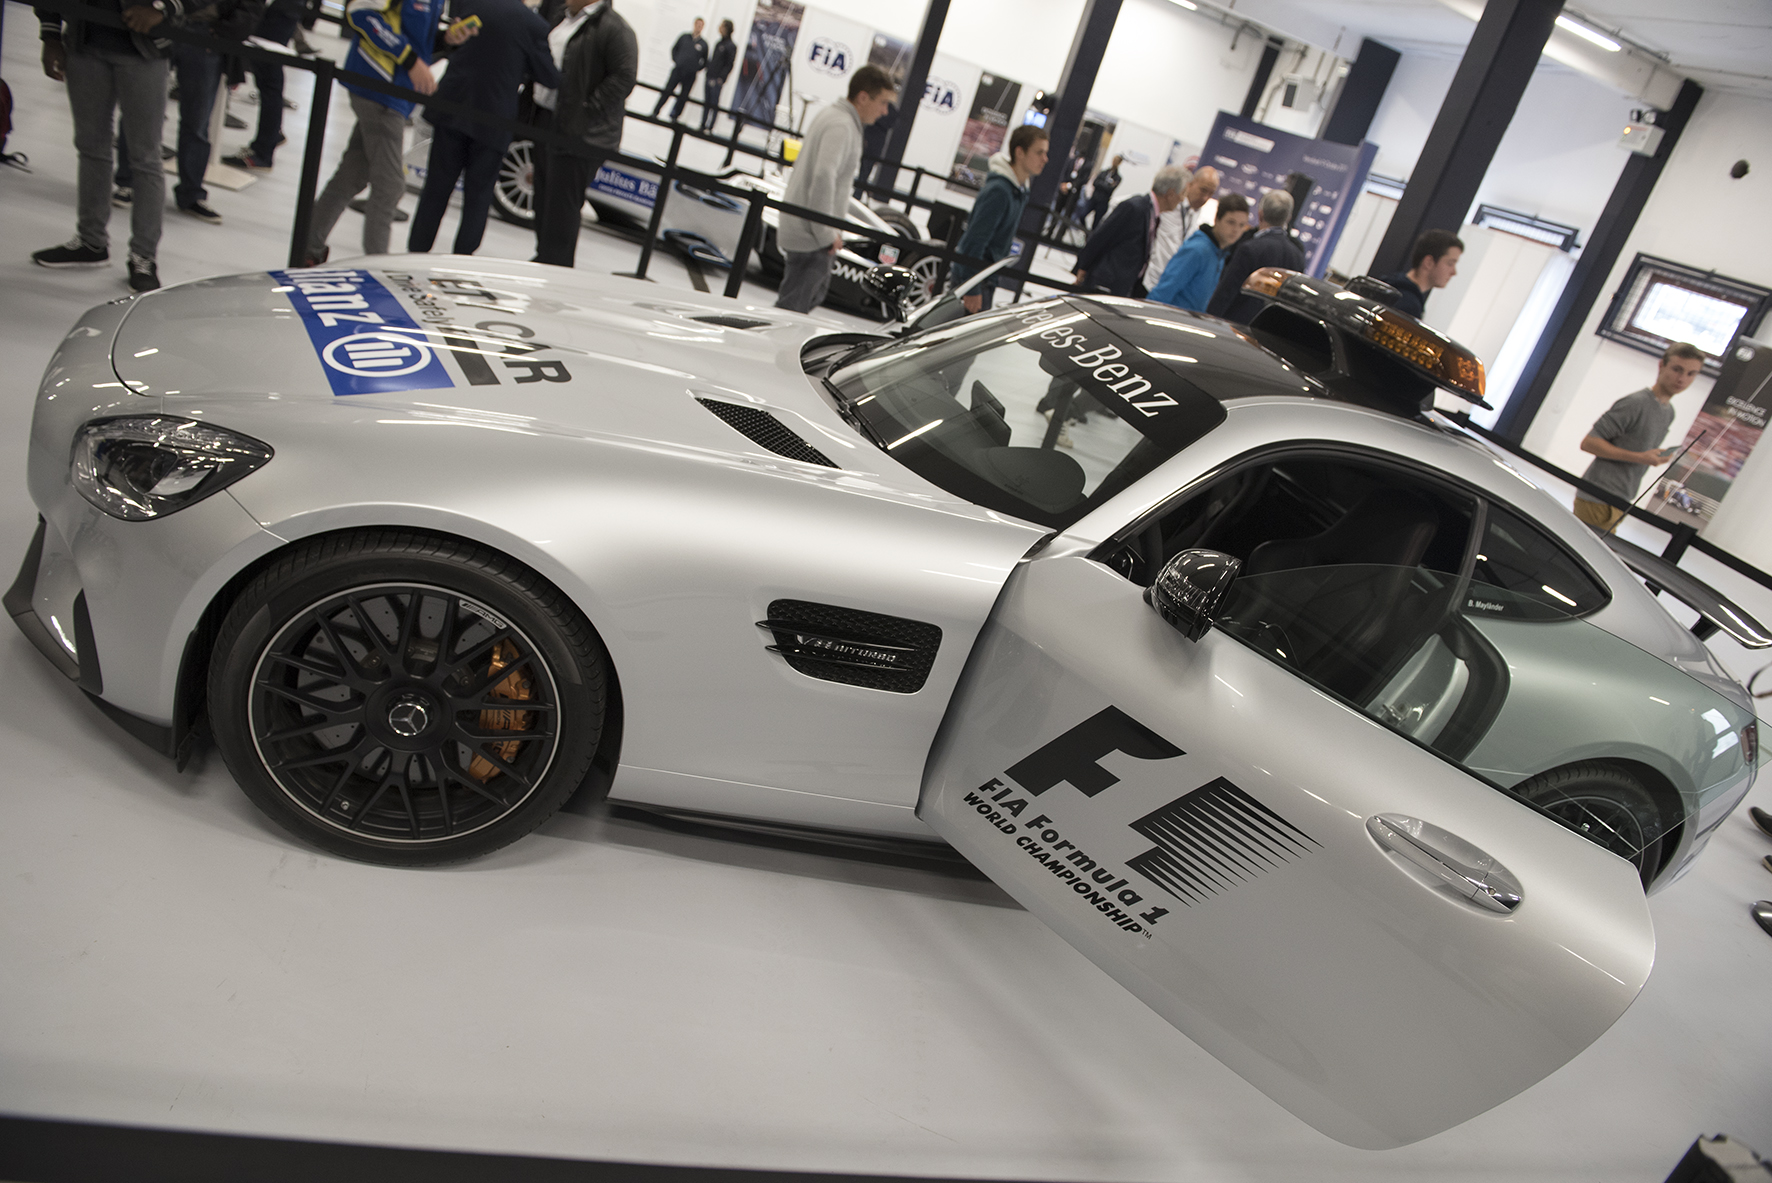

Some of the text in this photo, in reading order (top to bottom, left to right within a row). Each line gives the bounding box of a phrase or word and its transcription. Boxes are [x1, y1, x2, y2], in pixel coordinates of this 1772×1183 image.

[963, 791, 1017, 835] WORLD
[978, 777, 1170, 926] FIA Formula 1
